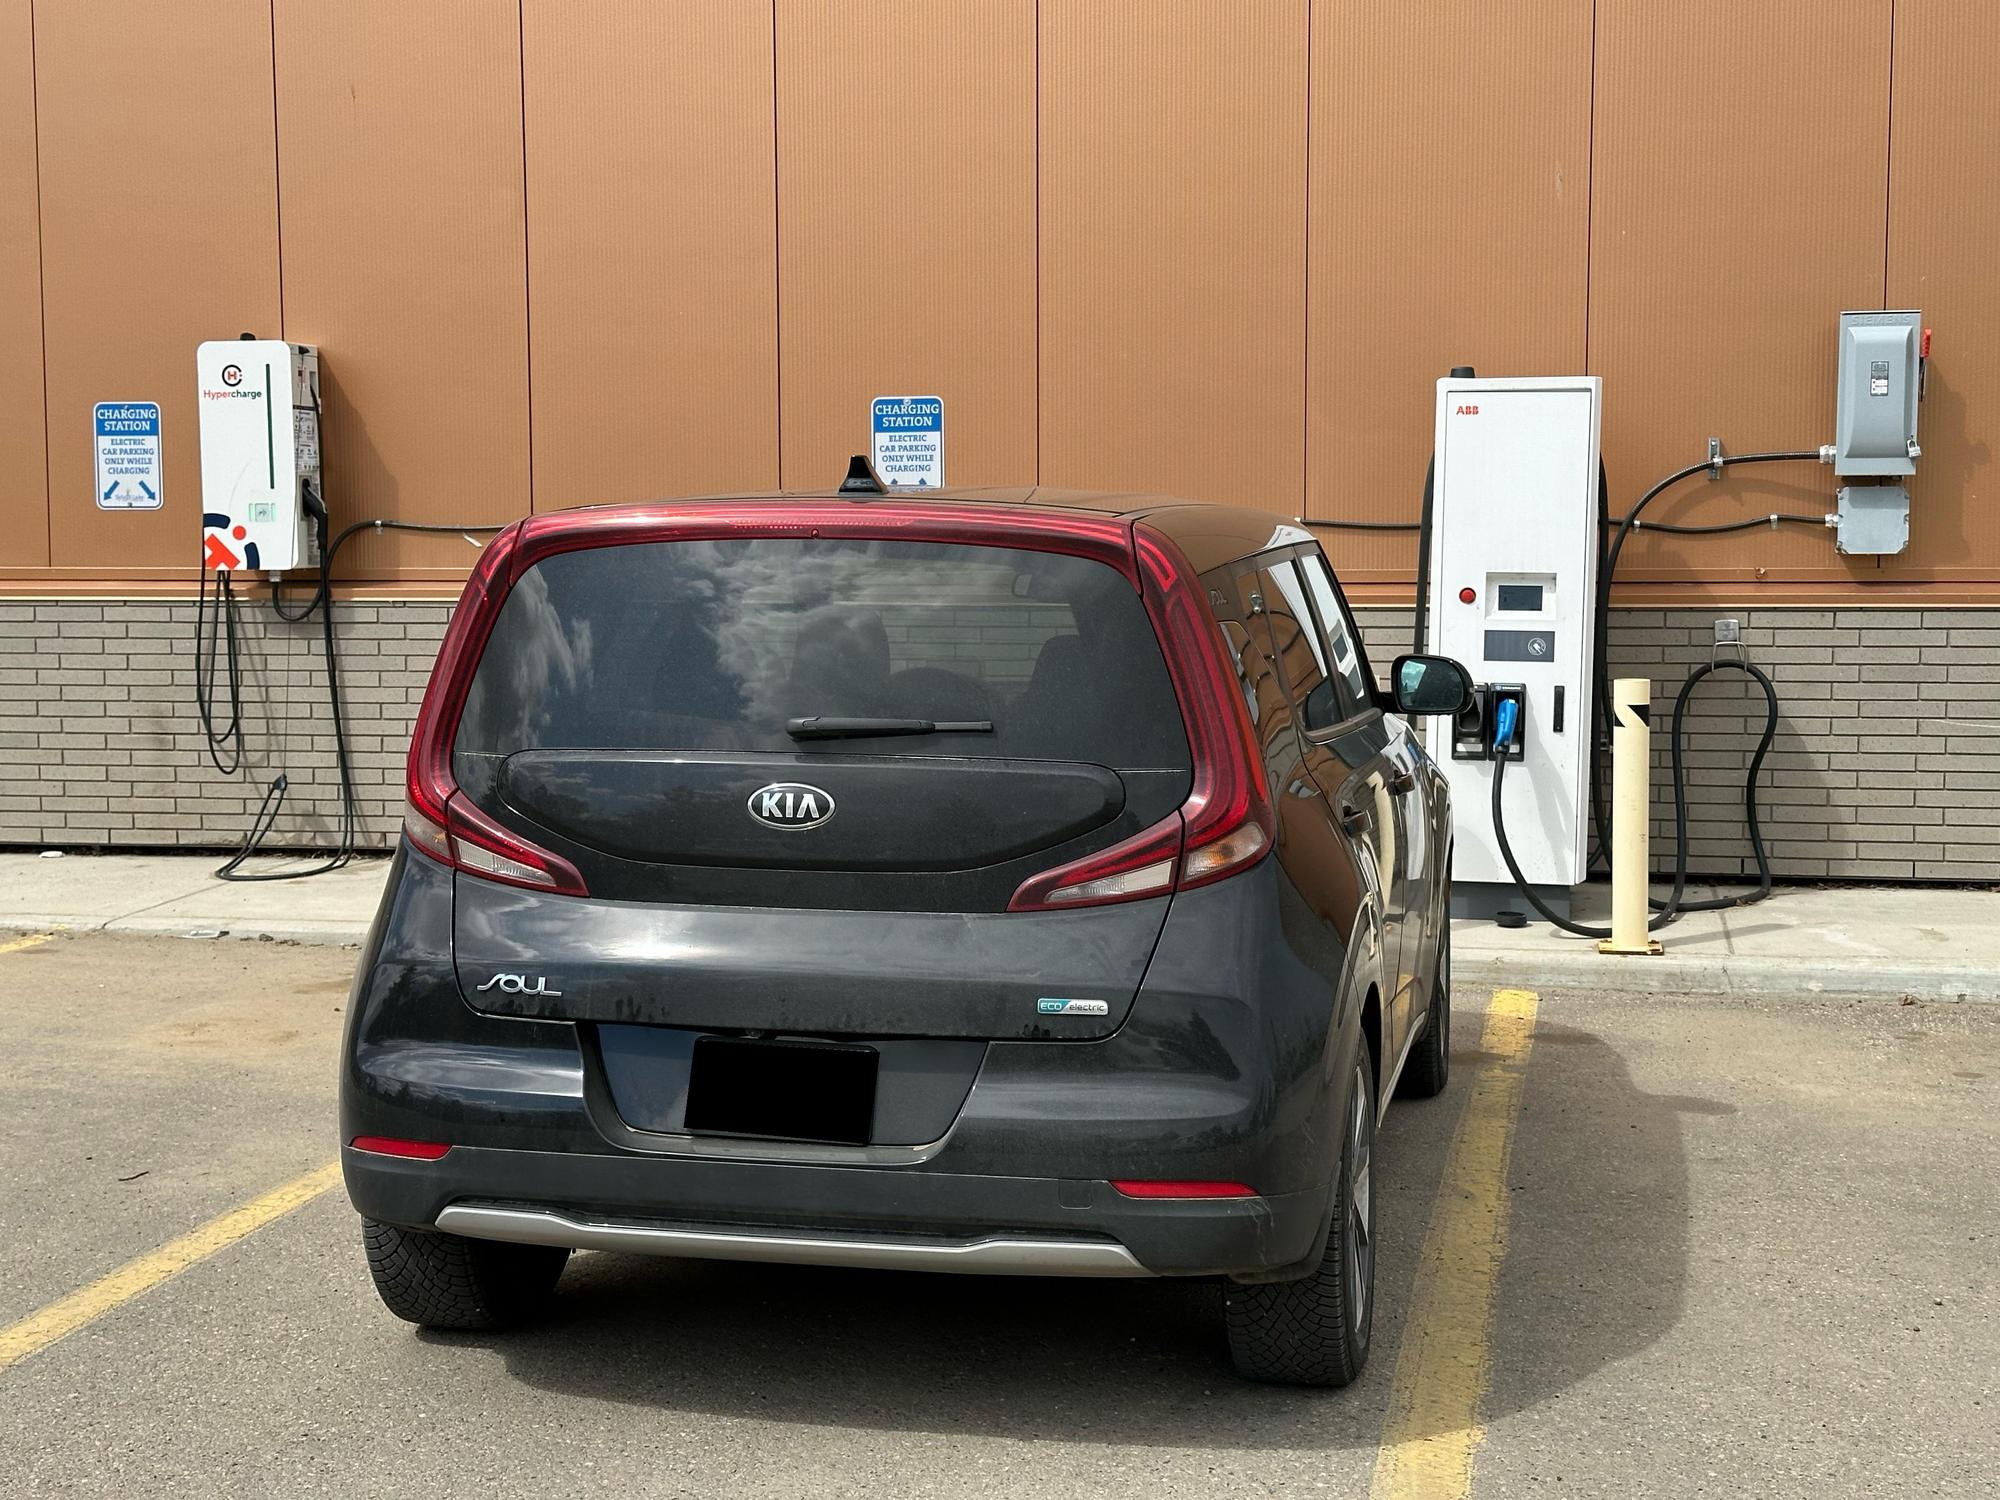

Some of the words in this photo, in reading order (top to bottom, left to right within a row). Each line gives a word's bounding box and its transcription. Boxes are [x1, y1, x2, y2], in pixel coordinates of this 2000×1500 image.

[1850, 314, 1913, 326] SIEMENS
[203, 389, 262, 400] Hypercharge
[97, 408, 157, 420] CHARGING
[875, 403, 940, 415] CHARGING
[1455, 405, 1479, 415] ABB
[104, 420, 150, 431] STATION
[882, 416, 933, 427] STATION
[110, 438, 146, 446] ELECTRIC
[888, 434, 927, 443] ELECTRIC
[102, 447, 118, 455] CAR
[119, 447, 155, 455] PARKING
[879, 445, 896, 453] CAR
[898, 444, 937, 453] PARKING
[104, 457, 126, 465] ONLY
[126, 457, 153, 465] WHILE
[881, 455, 905, 463] ONLY
[906, 454, 935, 462] WHILE
[107, 466, 150, 475] CHARGING
[885, 464, 932, 473] CHARGING
[761, 792, 820, 819] KIA
[476, 973, 562, 997] SOUL
[1040, 1002, 1062, 1010] ECO
[1069, 1003, 1105, 1012] electric
